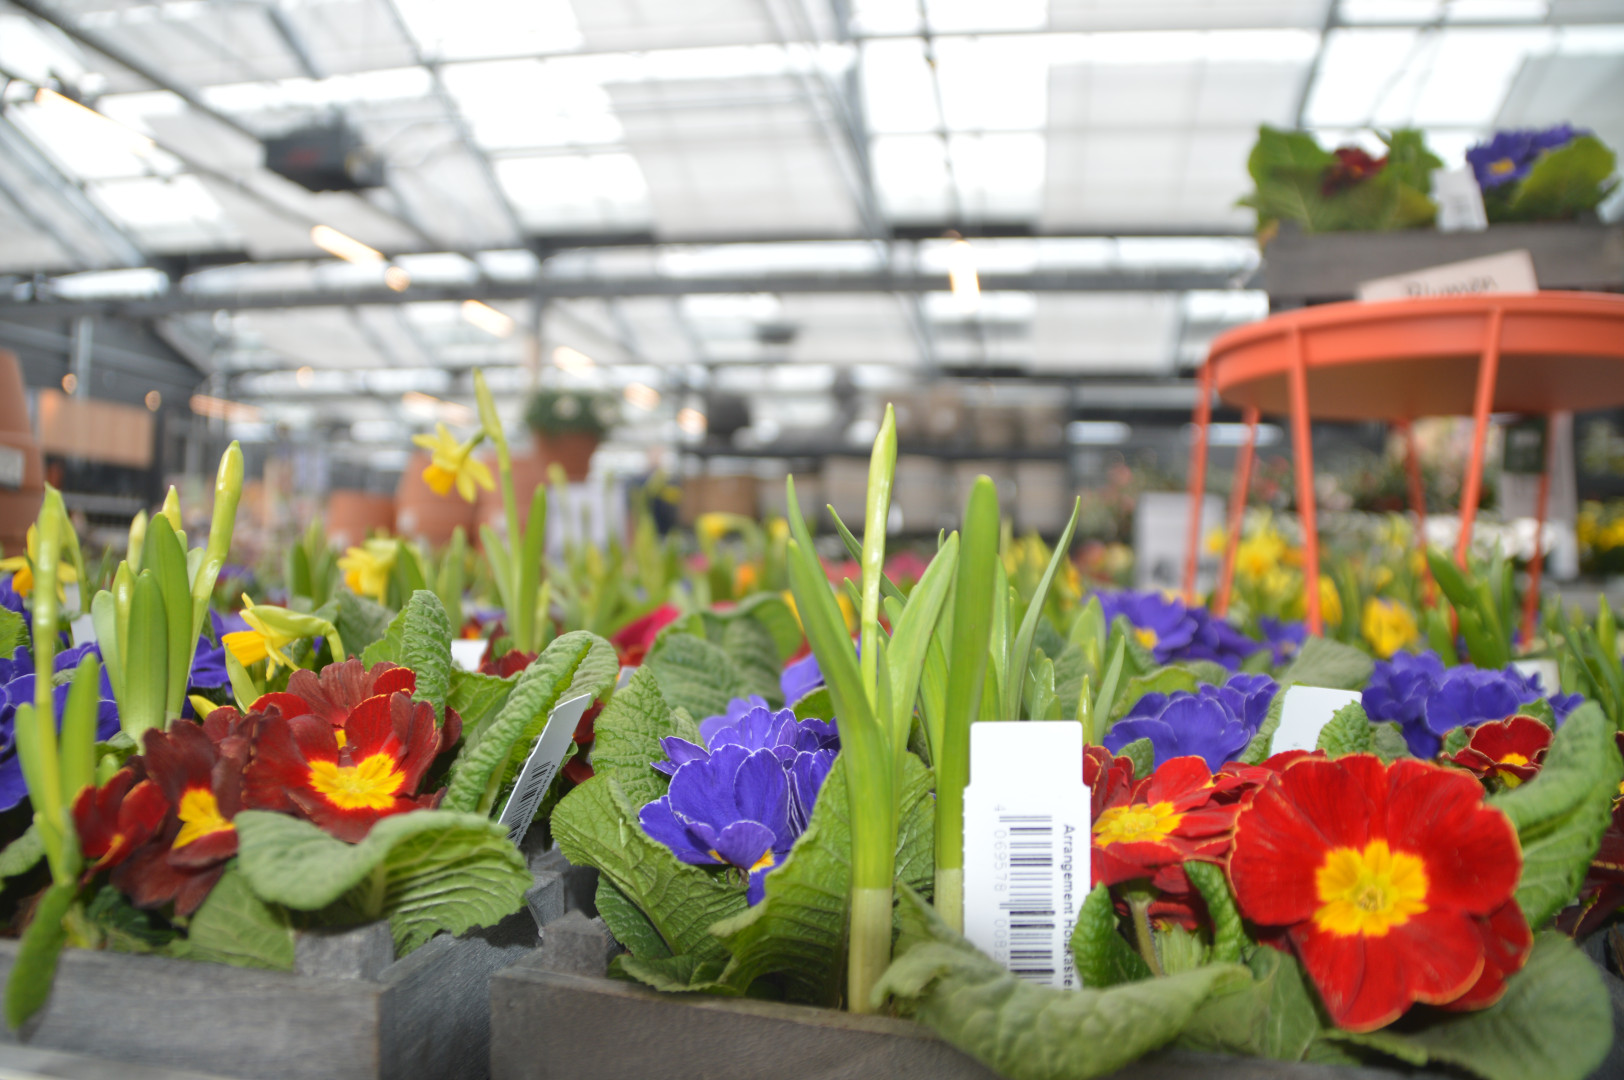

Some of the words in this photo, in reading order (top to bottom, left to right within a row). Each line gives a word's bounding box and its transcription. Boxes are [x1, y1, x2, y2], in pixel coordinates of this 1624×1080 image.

[994, 804, 1007, 812] 4
[994, 829, 1008, 892] 069578
[1061, 824, 1075, 914] Arrangement
